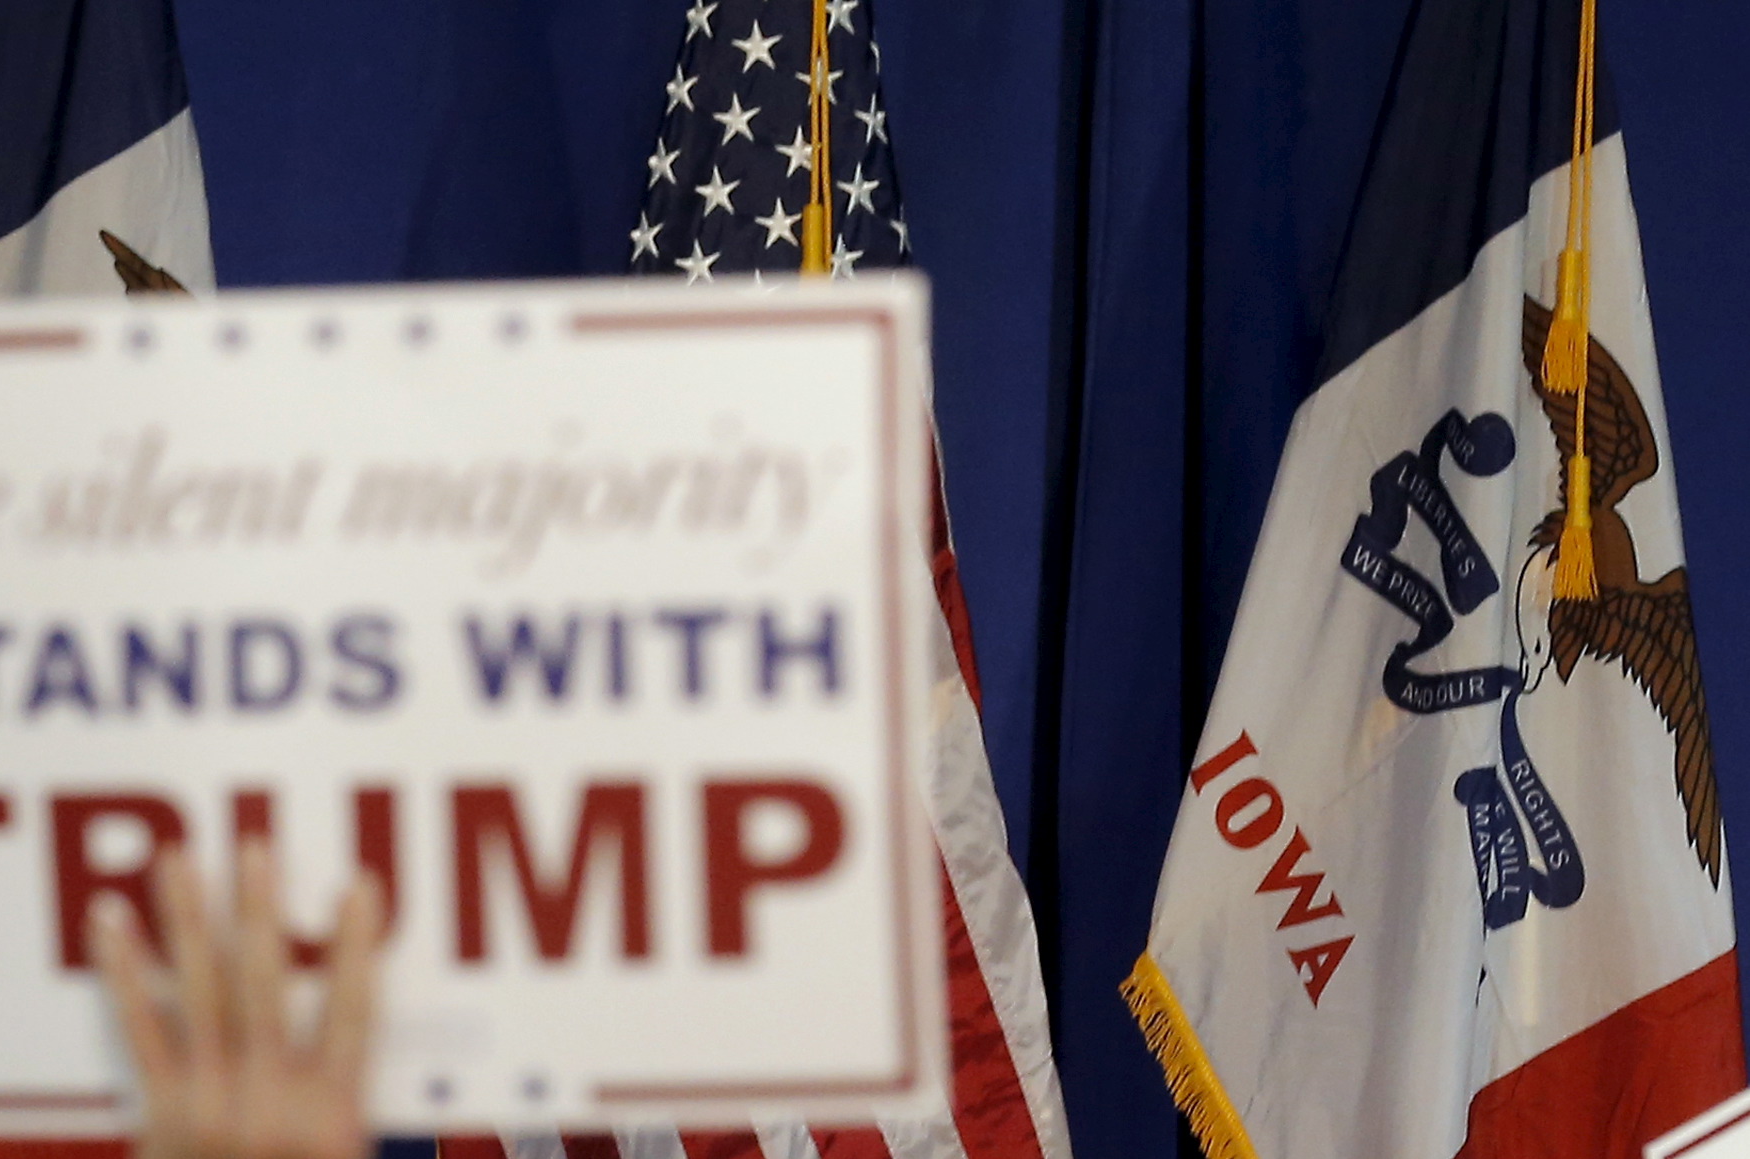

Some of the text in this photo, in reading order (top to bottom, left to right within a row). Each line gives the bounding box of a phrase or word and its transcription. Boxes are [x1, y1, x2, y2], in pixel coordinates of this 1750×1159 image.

[22, 425, 327, 555] silent
[338, 420, 820, 577] majority
[1397, 463, 1476, 578] LIBERTIES
[1352, 544, 1388, 585] WE
[464, 602, 850, 708] WITH
[1436, 675, 1485, 702] OUR
[1190, 728, 1357, 1010] IOWA
[1498, 828, 1522, 901] WILL
[1509, 758, 1570, 872] RIGHTS
